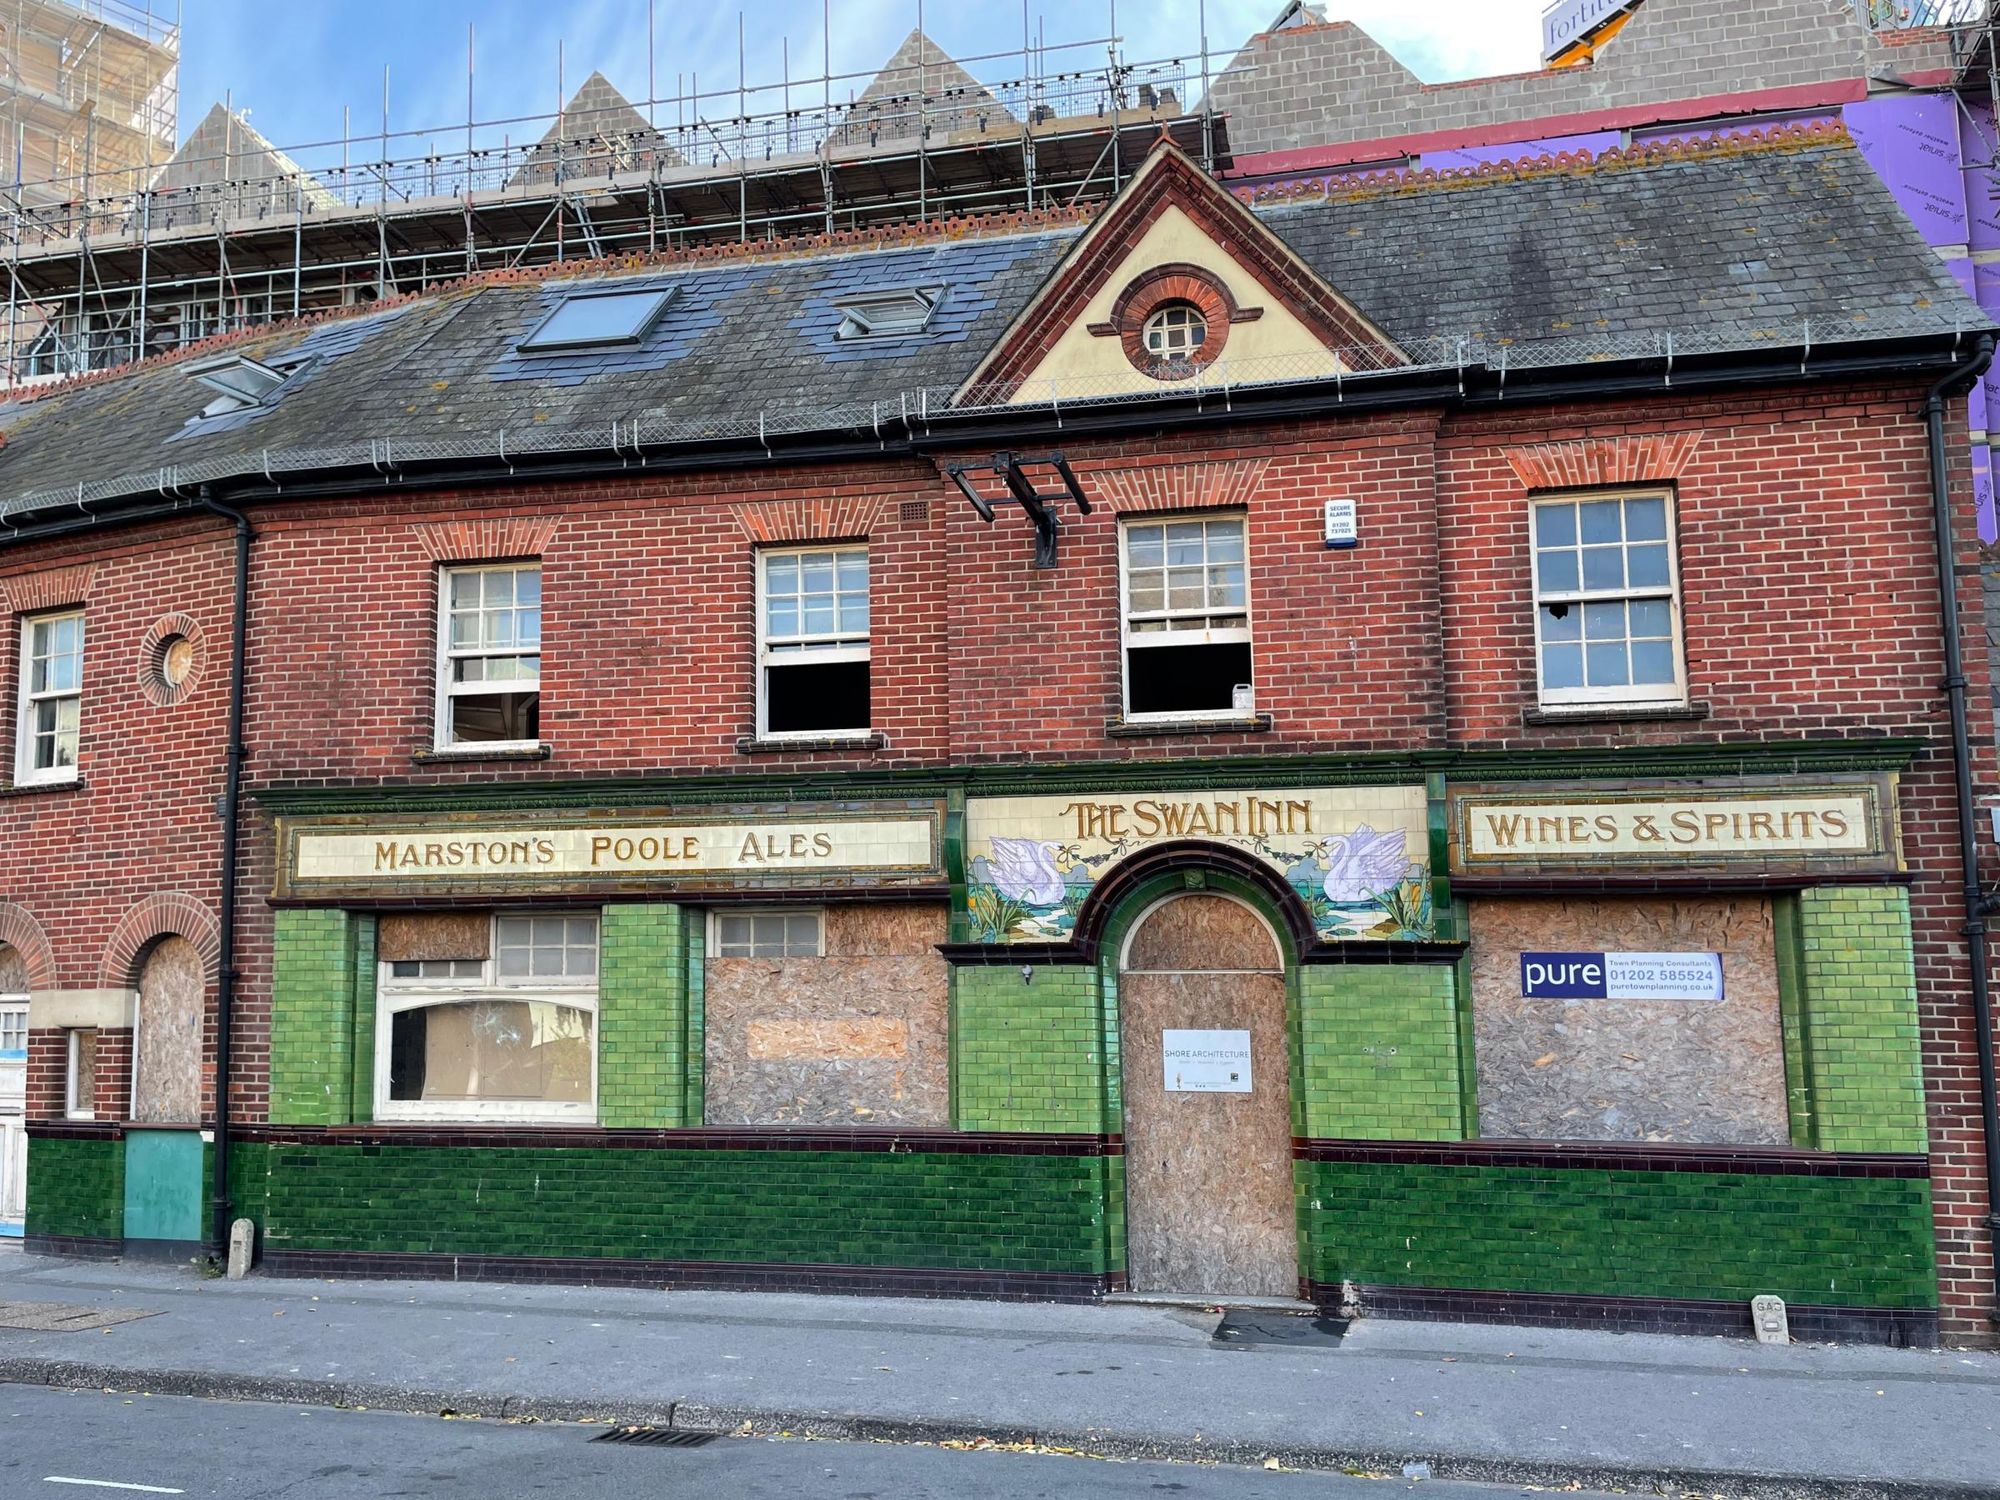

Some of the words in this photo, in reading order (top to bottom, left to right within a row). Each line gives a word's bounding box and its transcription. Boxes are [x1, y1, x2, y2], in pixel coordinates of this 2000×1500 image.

[1059, 802, 1131, 845] THE
[1133, 800, 1240, 838] SWAN
[1247, 796, 1314, 839] INN
[1486, 813, 1619, 848] WINES
[1631, 815, 1666, 843] &
[1669, 809, 1849, 845] SPIRITS
[374, 836, 556, 871] MARSTON'S
[590, 836, 701, 864] POOLE
[739, 832, 835, 864] ALES
[1631, 960, 1663, 968] Planning
[1526, 962, 1600, 993] pure
[1610, 970, 1654, 981] 01202
[1660, 970, 1713, 981] 585524
[1610, 983, 1714, 992] puretownplanning.co.uk
[1165, 1050, 1190, 1058] SHORE
[1192, 1050, 1249, 1059] ARCHITECTURE
[1757, 1302, 1782, 1311] GAS
